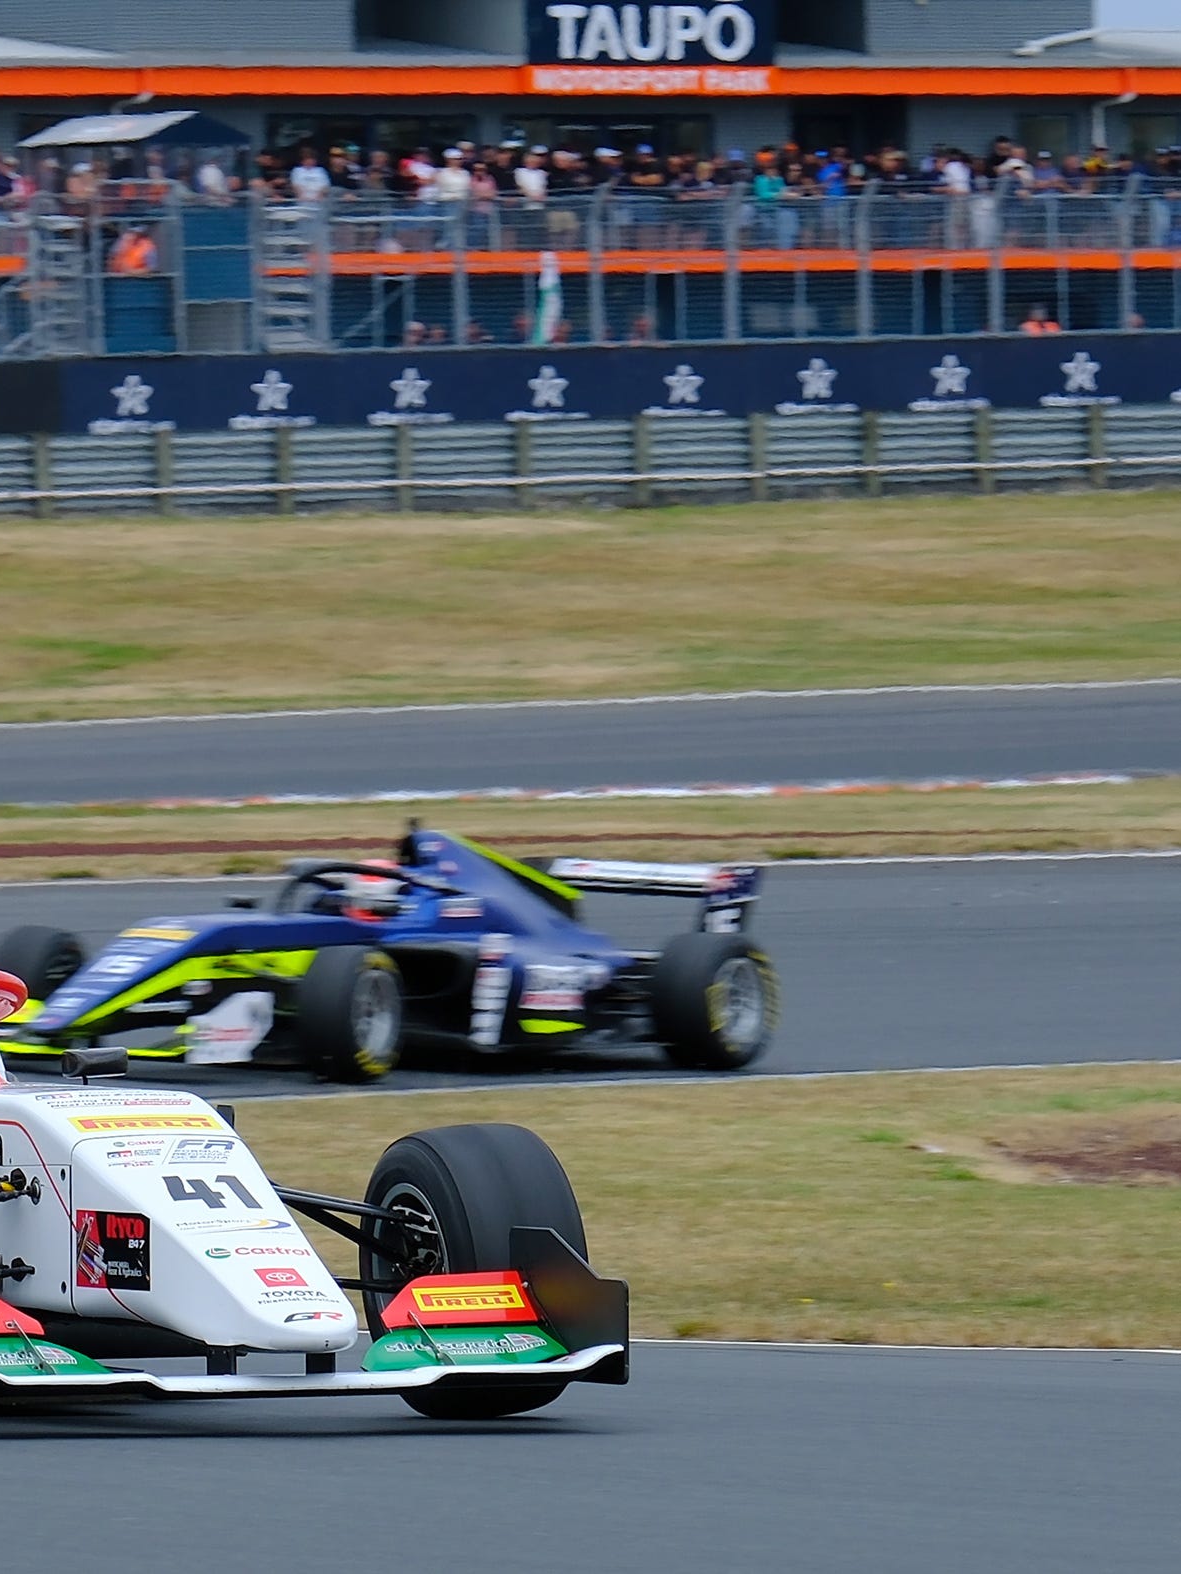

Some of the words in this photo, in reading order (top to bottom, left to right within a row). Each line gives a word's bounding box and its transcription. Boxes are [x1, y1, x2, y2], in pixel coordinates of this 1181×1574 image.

[703, 69, 769, 92] PARK
[77, 1116, 212, 1130] PIRELLI
[161, 1174, 264, 1209] 41
[234, 1246, 312, 1257] Castrol
[260, 1289, 327, 1299] TOYOTA
[420, 1290, 516, 1307] PIRELLI
[283, 1311, 344, 1323] GR
